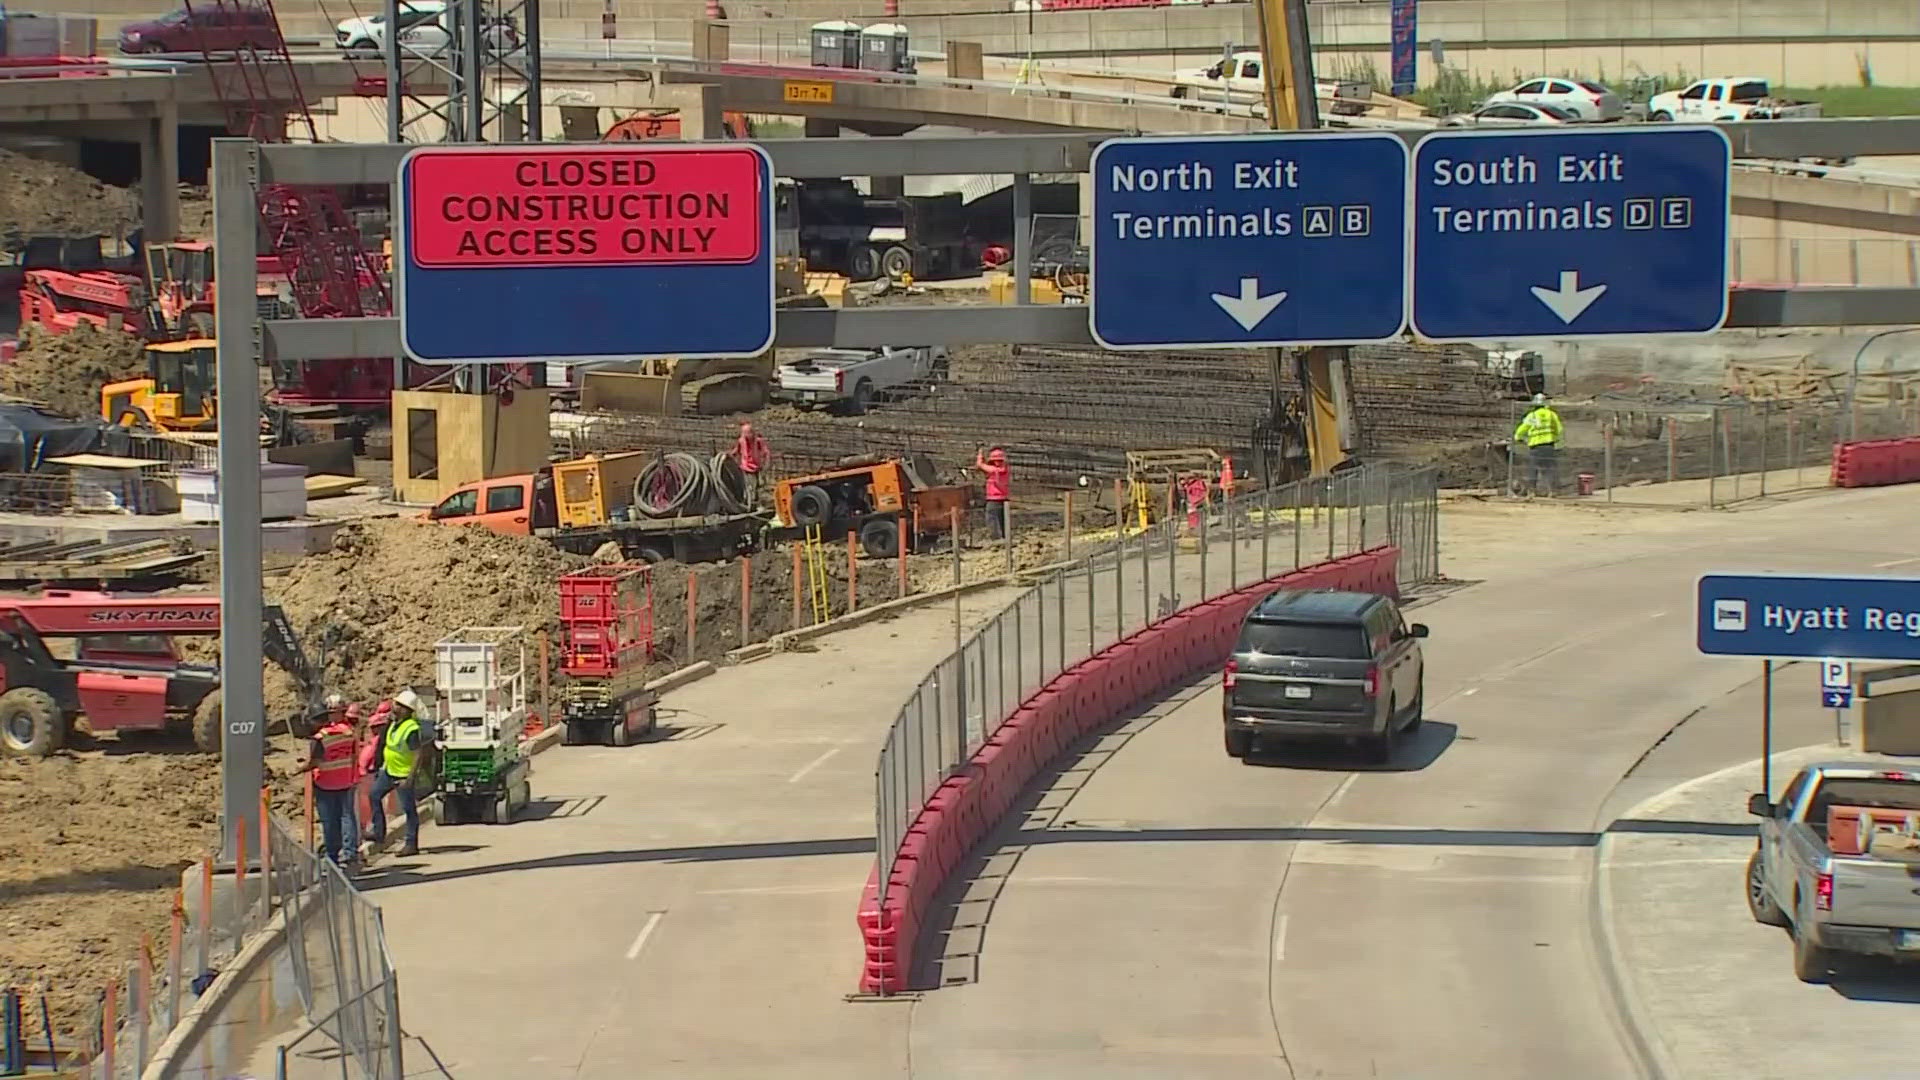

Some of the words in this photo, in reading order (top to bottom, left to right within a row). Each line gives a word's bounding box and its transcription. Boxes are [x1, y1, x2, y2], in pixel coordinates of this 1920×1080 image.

[515, 159, 656, 187] CLOSED
[1112, 161, 1213, 193] North
[1234, 159, 1299, 189] Exit
[1433, 155, 1537, 186] South
[1558, 153, 1624, 182] Exit
[442, 193, 729, 222] CONSTRUCTION
[1432, 201, 1613, 232] Terminals
[1629, 204, 1647, 225] D
[1112, 208, 1292, 239] Terminals
[1307, 211, 1328, 232] A
[456, 228, 598, 256] ACCESS
[621, 226, 717, 254] ONLY
[90, 609, 217, 622] SKYTRAK
[1763, 605, 1848, 634] Hyatt
[1864, 608, 1920, 637] Reg
[457, 665, 477, 674] JLG
[1830, 664, 1842, 682] P
[229, 721, 256, 735] C07
